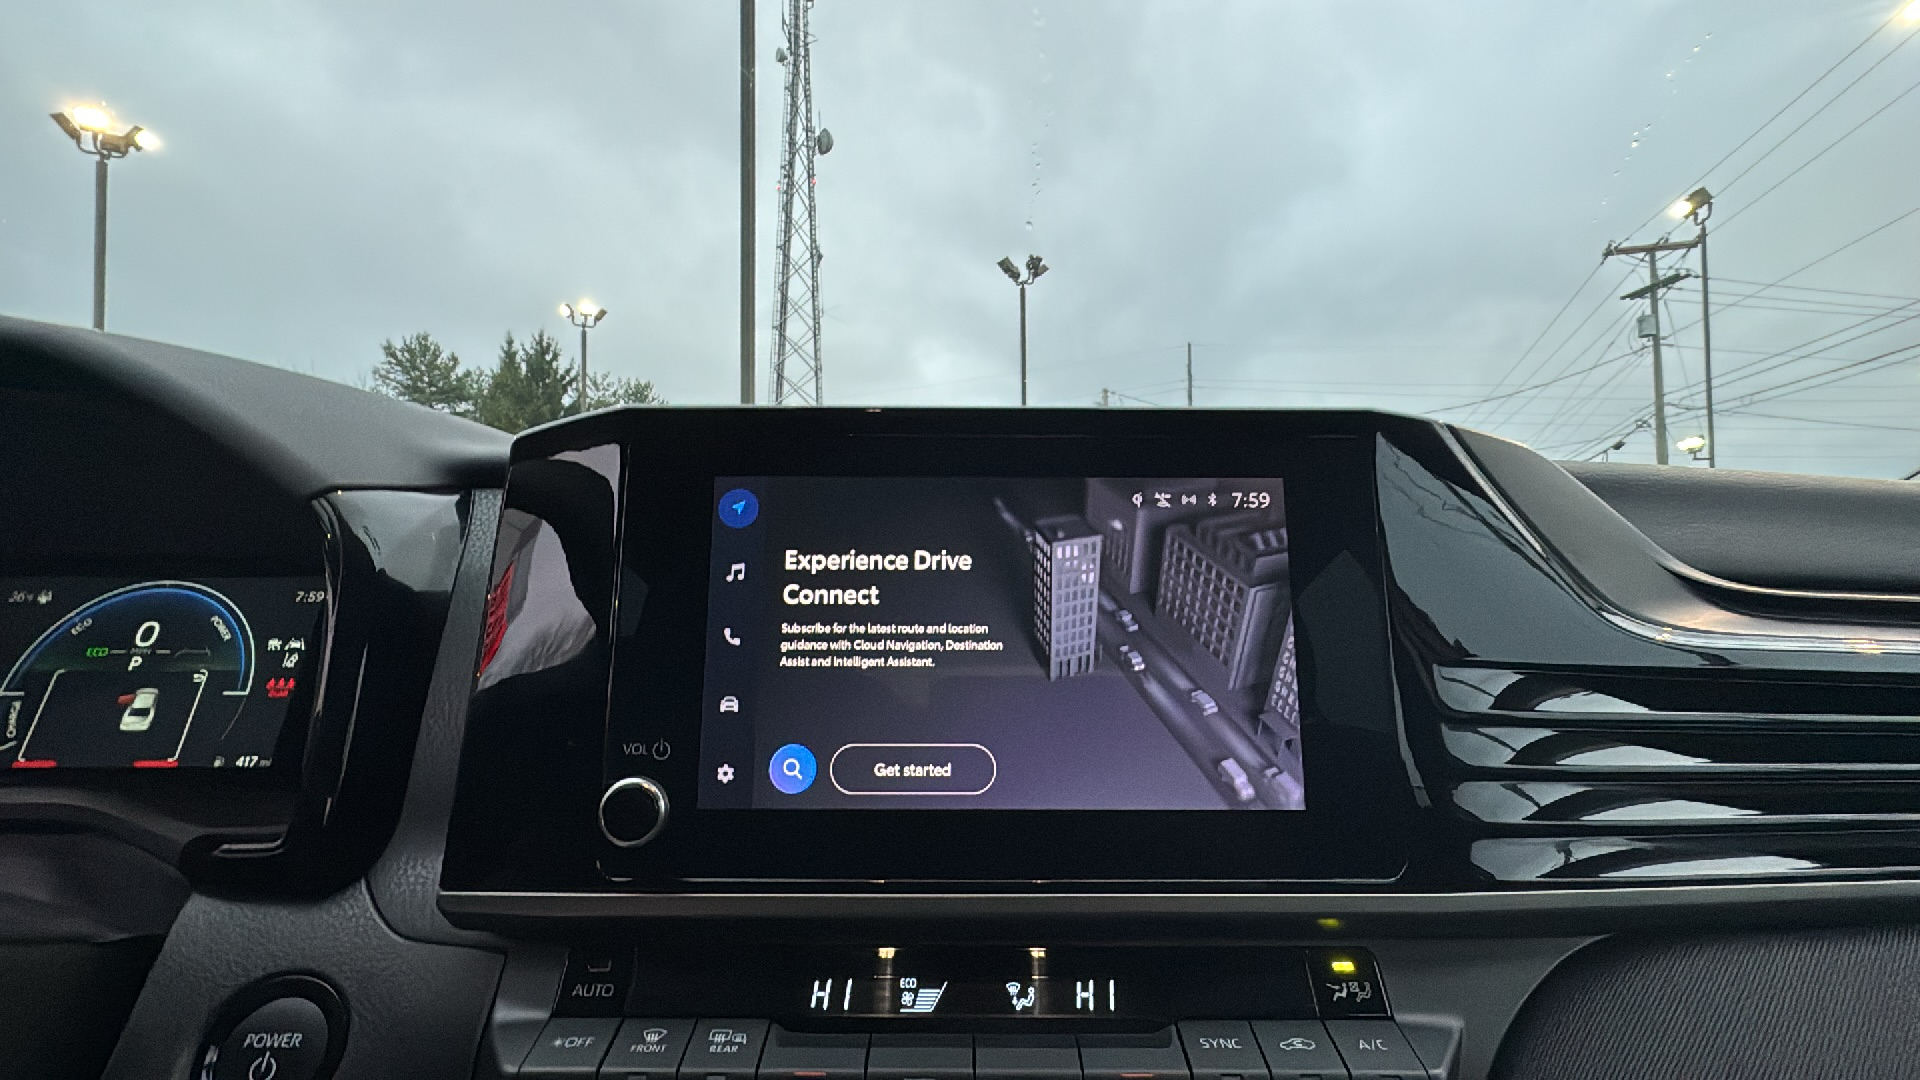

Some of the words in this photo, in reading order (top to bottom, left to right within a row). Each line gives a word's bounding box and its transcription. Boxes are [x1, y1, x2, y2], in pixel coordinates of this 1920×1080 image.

[1231, 491, 1271, 509] 7:59
[784, 549, 909, 573] Experience
[913, 549, 972, 571] Drive
[295, 590, 325, 603] 7:59
[783, 583, 880, 606] Connect
[135, 620, 160, 647] 0
[781, 622, 832, 634] Subscribe
[832, 622, 848, 634] for
[848, 622, 866, 634] the
[867, 622, 897, 634] latest
[897, 623, 925, 634] route
[926, 622, 947, 634] and
[948, 623, 989, 634] location
[780, 639, 829, 652] guidance
[829, 639, 852, 651] with
[853, 639, 885, 651] Cloud
[886, 639, 944, 652] Navigation,
[945, 639, 1004, 651] Destination
[127, 655, 143, 672] P
[779, 656, 811, 668] Assist
[811, 656, 832, 667] and
[833, 656, 885, 670] Intelligent
[886, 656, 936, 668] Assistant.
[622, 742, 649, 755] VOL
[235, 755, 259, 768] 417
[873, 762, 901, 778] Get
[903, 762, 952, 778] started
[900, 977, 917, 990] ECO
[571, 983, 615, 998] AUTO
[242, 1033, 303, 1049] POWER
[564, 1036, 595, 1049] OFF
[1199, 1037, 1243, 1050] SYNC
[1358, 1038, 1389, 1051] A/C
[629, 1044, 668, 1053] FRONT
[709, 1045, 739, 1053] REAR
